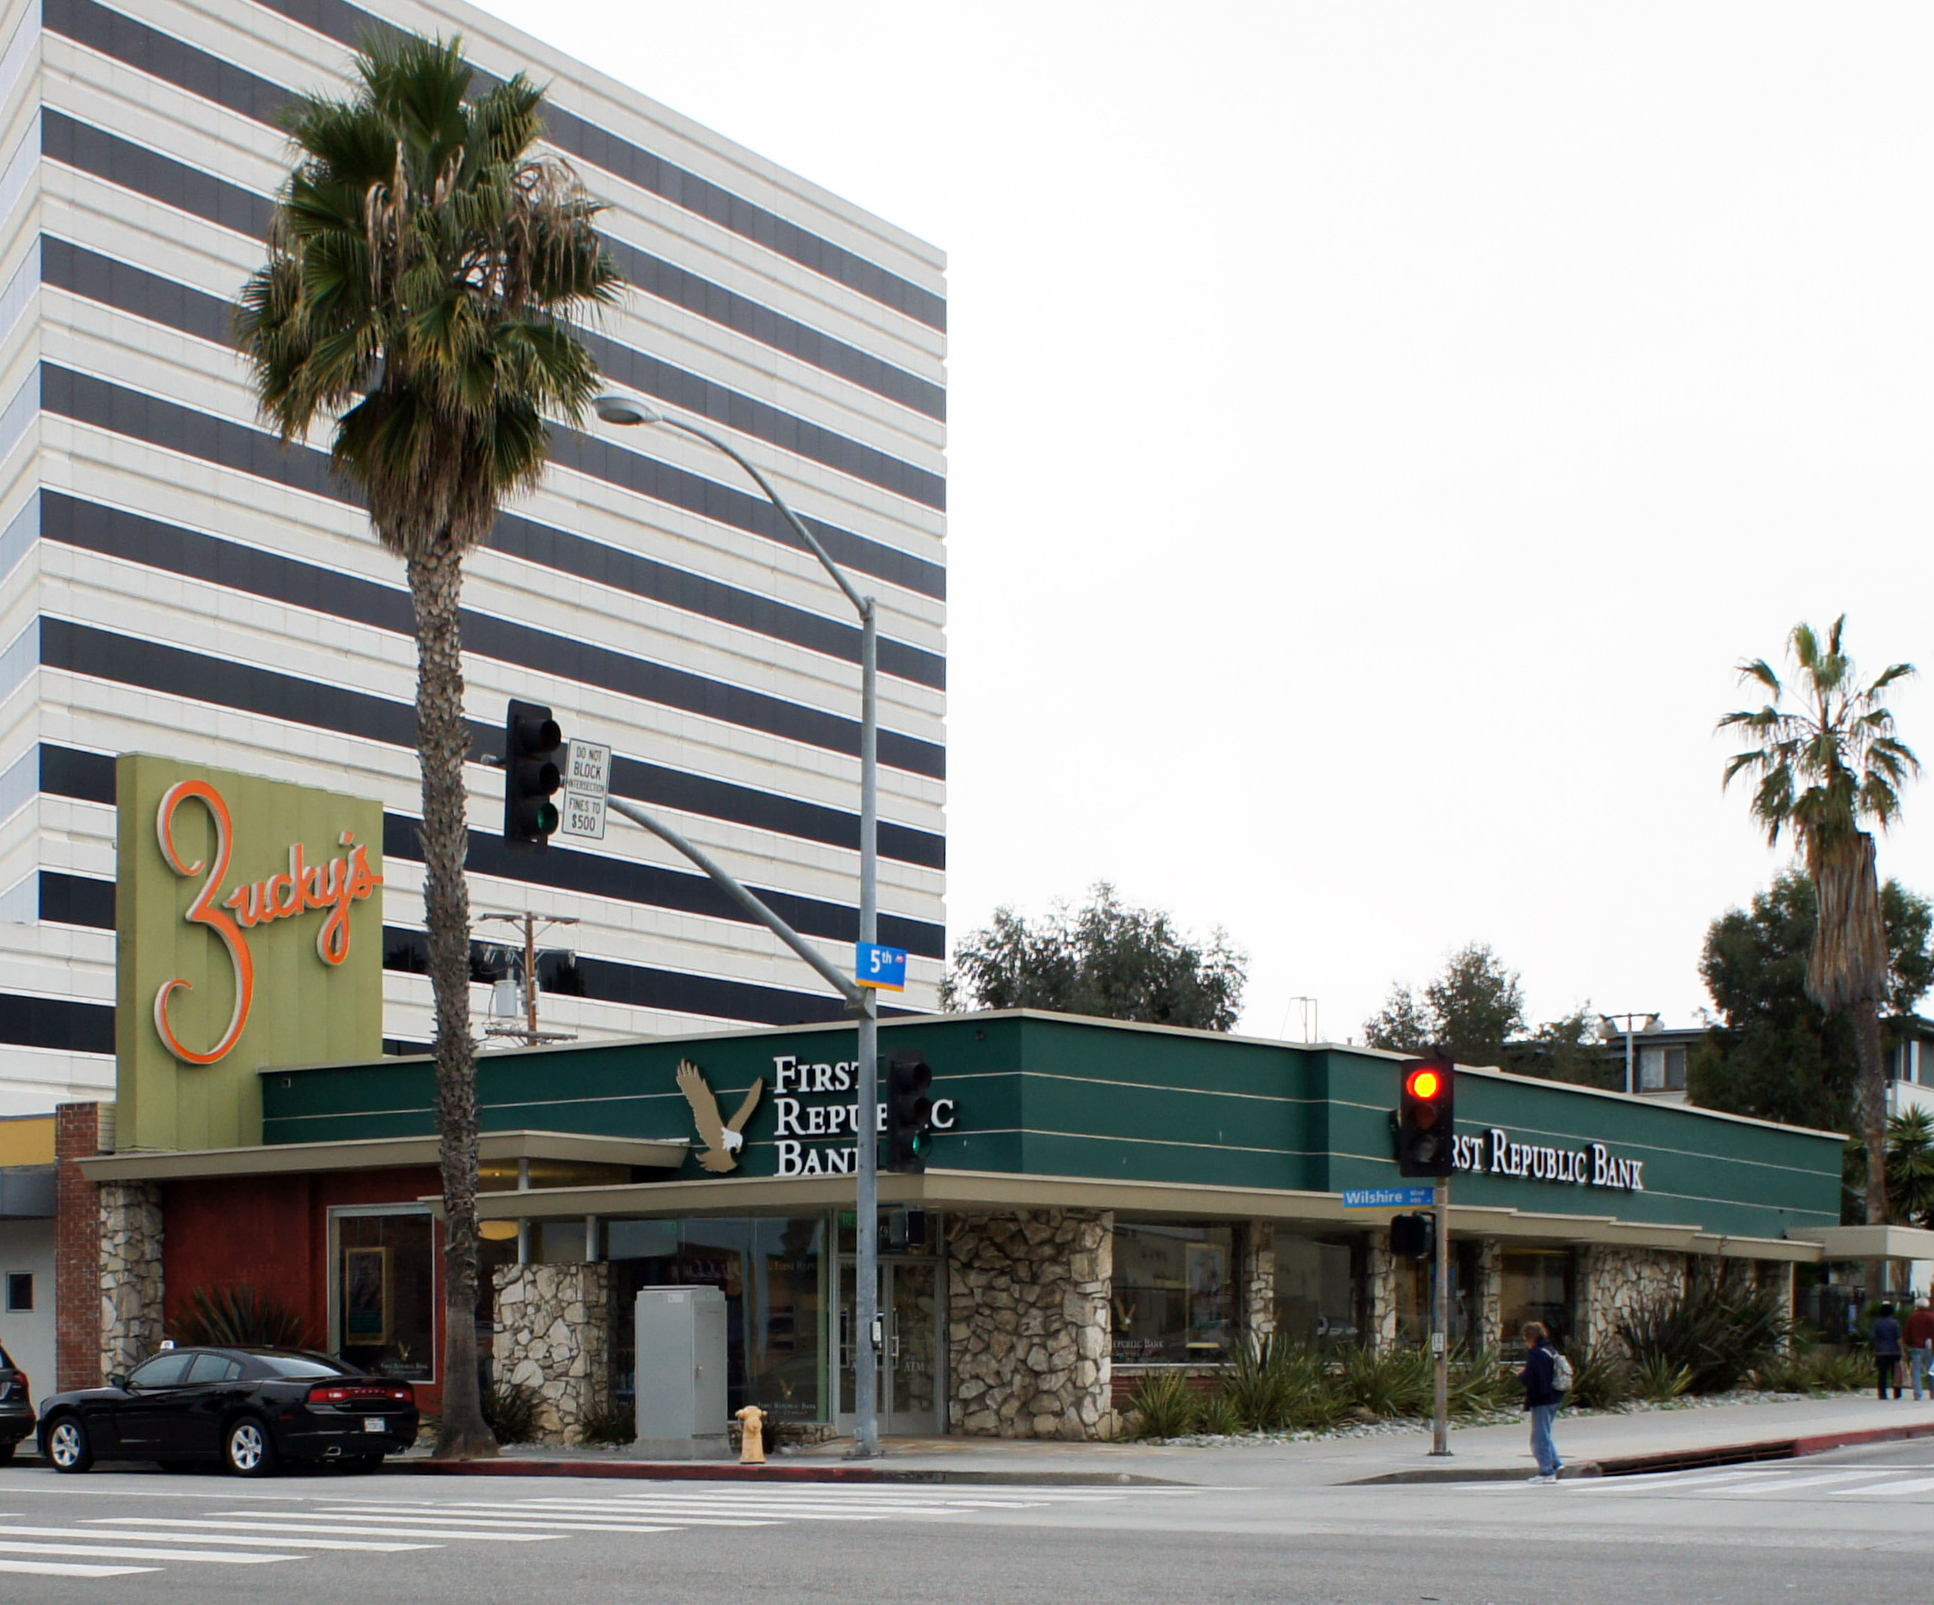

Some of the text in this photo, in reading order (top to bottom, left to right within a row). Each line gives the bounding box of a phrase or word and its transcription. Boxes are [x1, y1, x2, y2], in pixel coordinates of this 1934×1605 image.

[576, 746, 603, 761] DO NOT
[573, 761, 602, 780] BLOCK
[566, 779, 605, 794] INTERSECTION
[568, 798, 601, 815] FINES TO
[571, 813, 596, 831] $500
[154, 780, 384, 1065] Zucky's
[870, 948, 893, 974] 5th
[1452, 1128, 1644, 1190] RST REPUBLIC BANK
[1346, 1189, 1403, 1204] Wilshire
[1113, 1339, 1143, 1348] EPUBLIC
